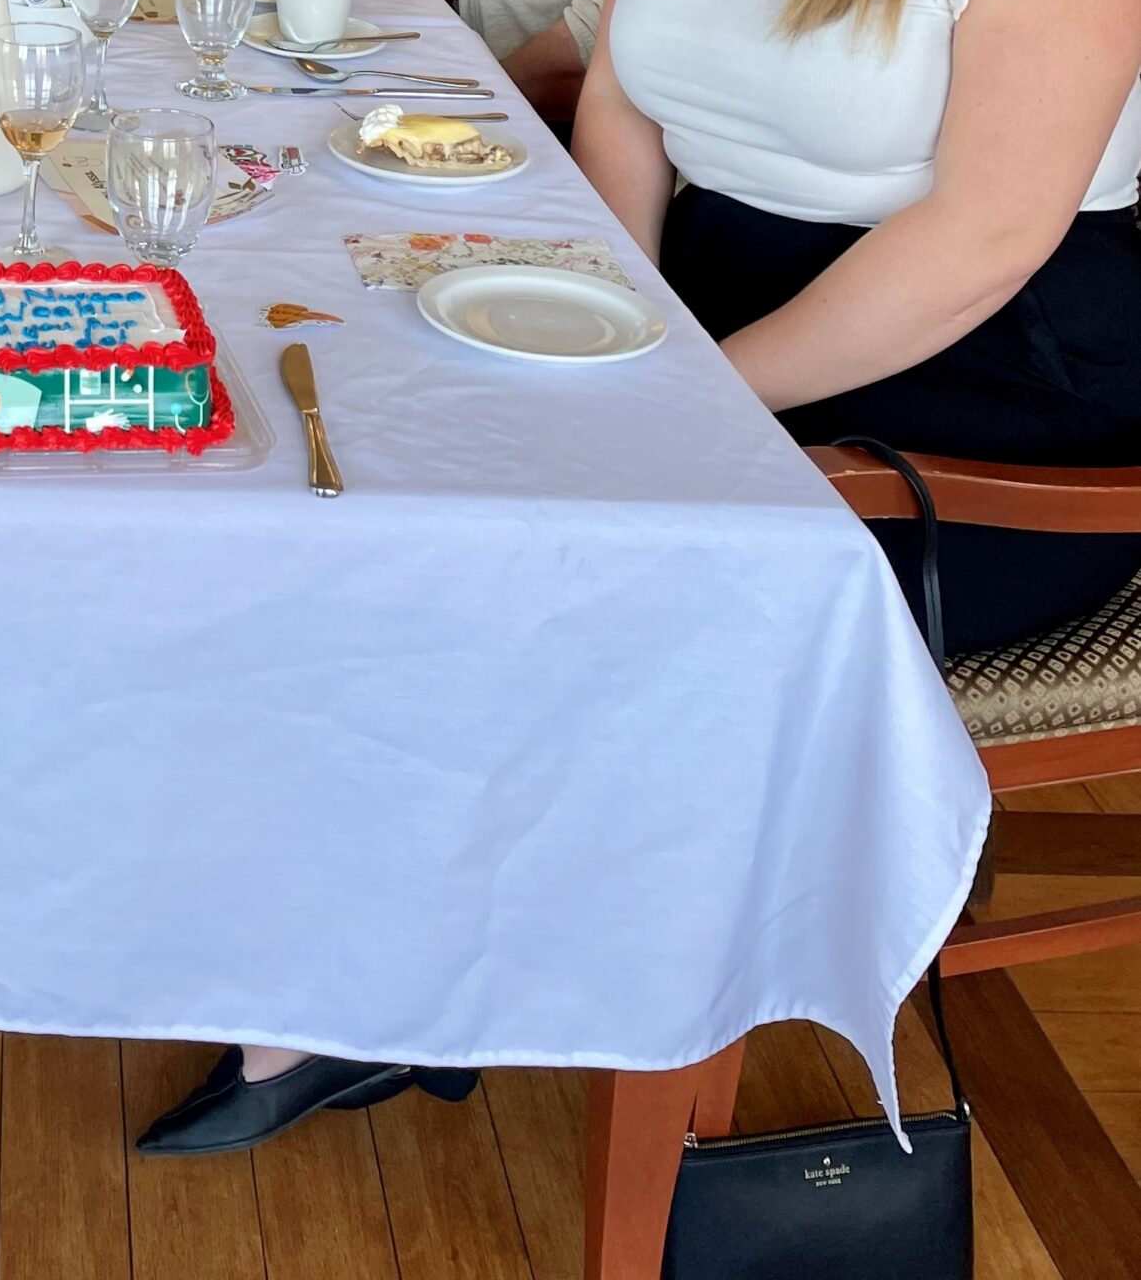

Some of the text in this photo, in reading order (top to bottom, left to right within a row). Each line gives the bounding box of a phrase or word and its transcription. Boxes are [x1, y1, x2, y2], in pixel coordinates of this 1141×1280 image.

[22, 321, 72, 340] you
[804, 1164, 850, 1179] kate spade
